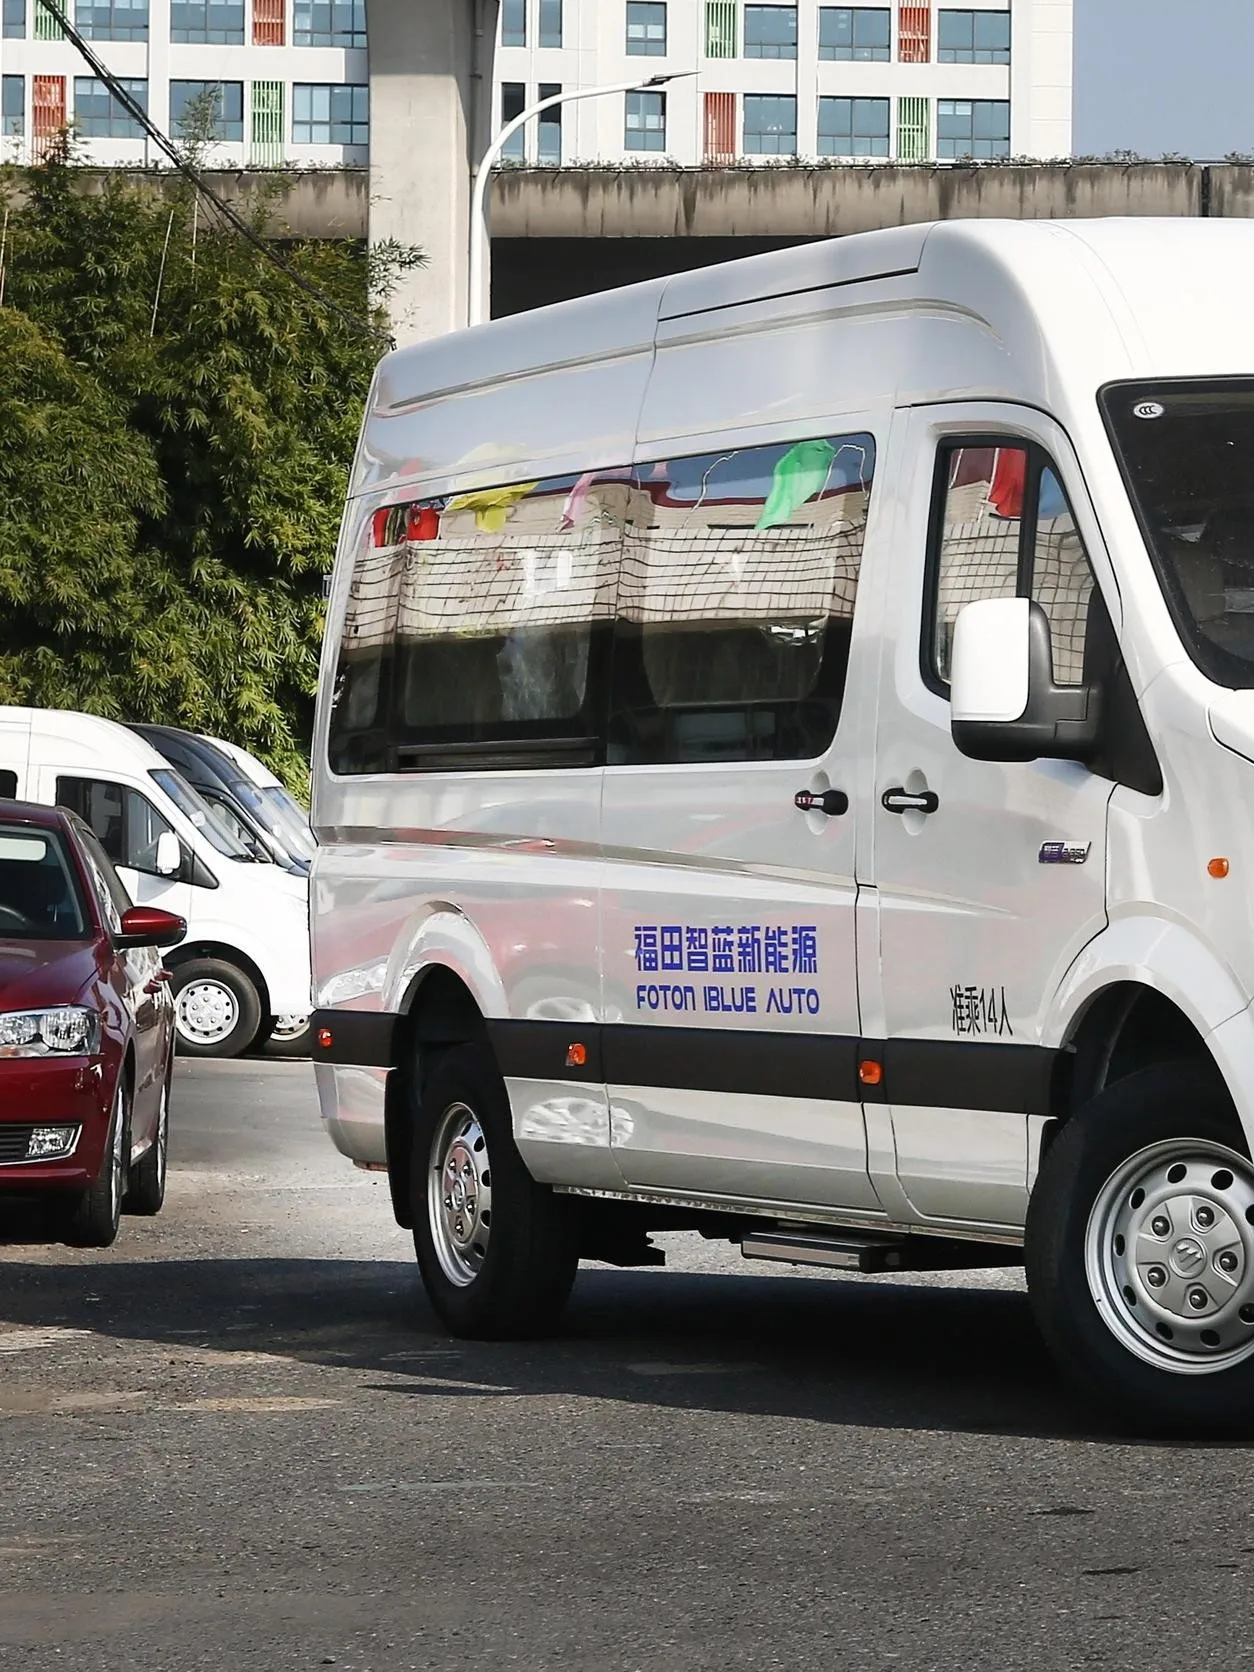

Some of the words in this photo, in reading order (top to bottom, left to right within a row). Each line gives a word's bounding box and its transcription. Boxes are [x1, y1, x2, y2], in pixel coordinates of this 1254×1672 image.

[634, 925, 818, 974] 福田智蓝新能源
[636, 984, 697, 1012] FOTON
[703, 985, 758, 1013] IBLUE
[765, 987, 820, 1015] AUTO
[949, 983, 1014, 1037] 准乘14人
